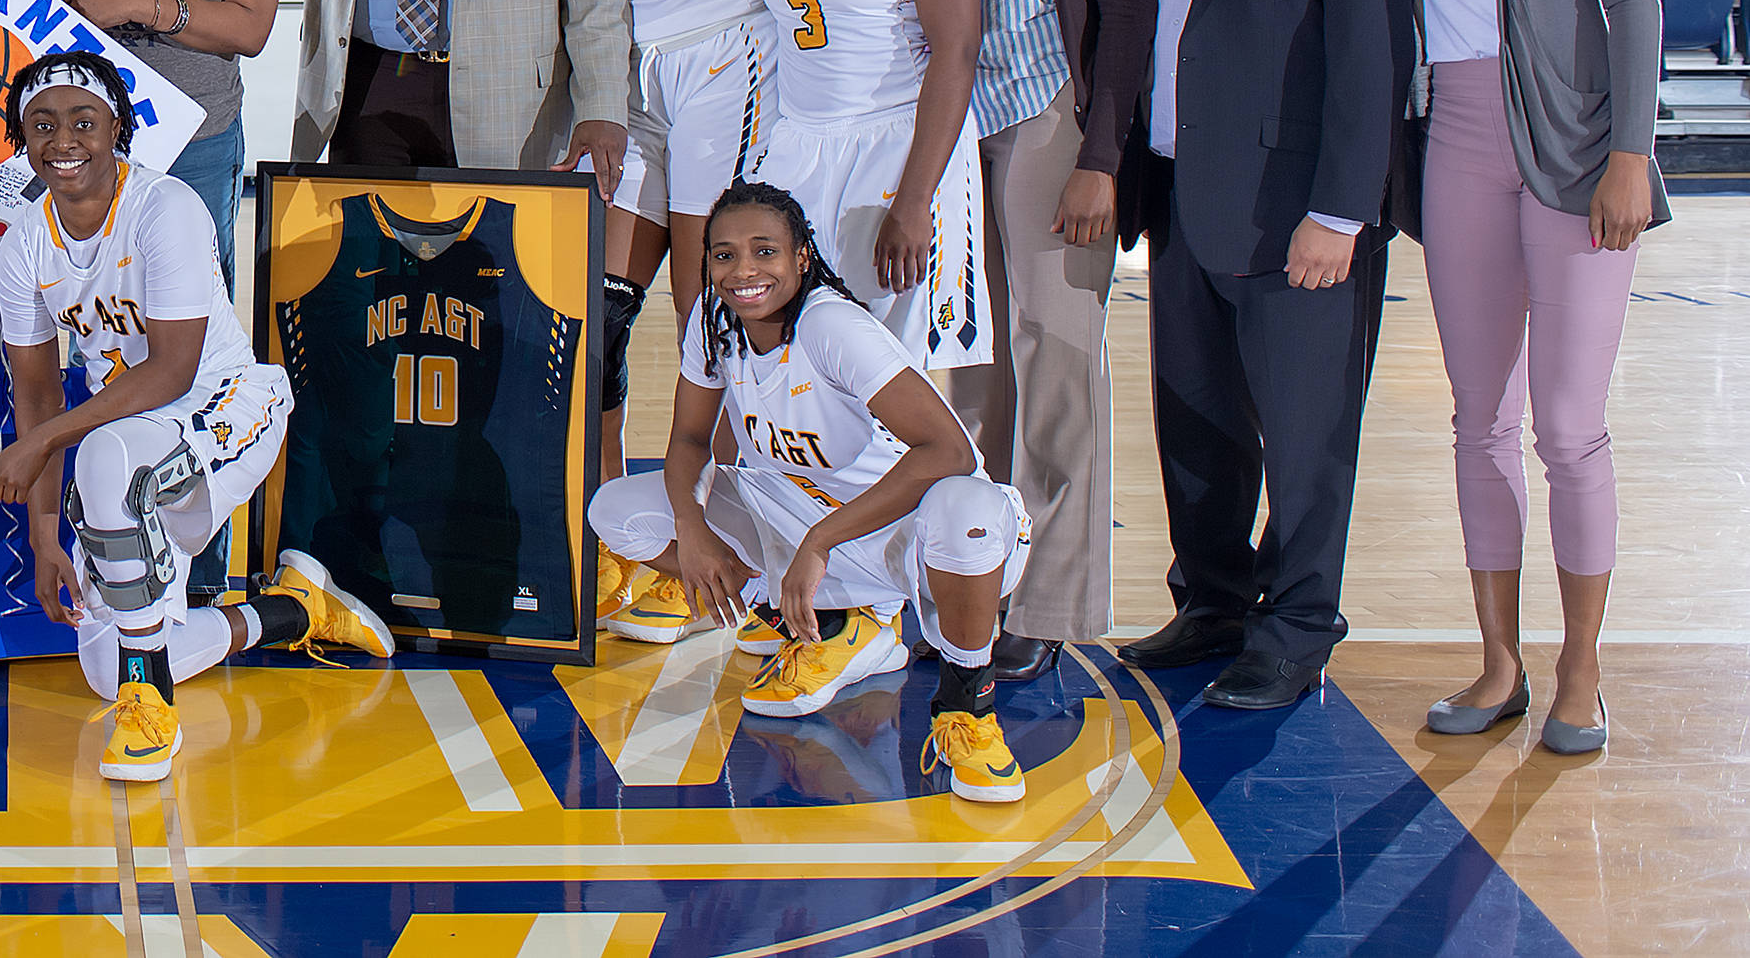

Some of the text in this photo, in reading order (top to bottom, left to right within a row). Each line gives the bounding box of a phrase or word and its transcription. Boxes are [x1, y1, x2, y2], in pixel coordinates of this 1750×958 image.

[477, 268, 506, 277] MEAC
[366, 293, 484, 351] NC A&T
[392, 353, 458, 426] 10
[744, 413, 833, 469] C A&T
[517, 585, 534, 596] XL
